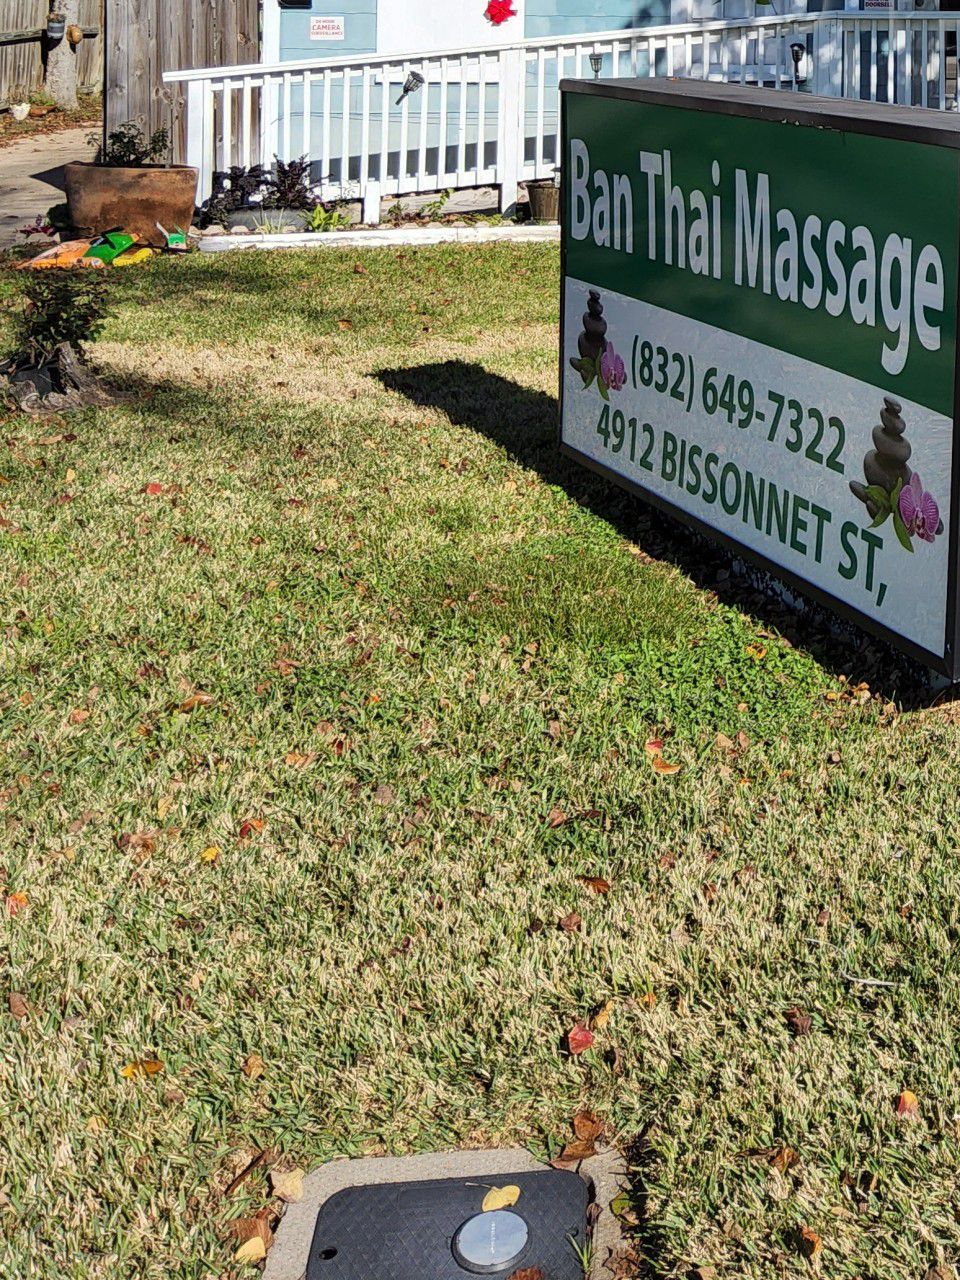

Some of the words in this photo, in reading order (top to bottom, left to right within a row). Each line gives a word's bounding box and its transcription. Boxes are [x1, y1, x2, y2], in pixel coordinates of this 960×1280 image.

[569, 138, 634, 255] Ban
[639, 149, 723, 280] Thai
[733, 168, 944, 376] Massage
[596, 404, 655, 473] 4912
[661, 430, 832, 564] BISSONNET
[837, 520, 889, 607] ST,
[631, 334, 695, 418] (832)
[701, 365, 846, 475] 649-7322
